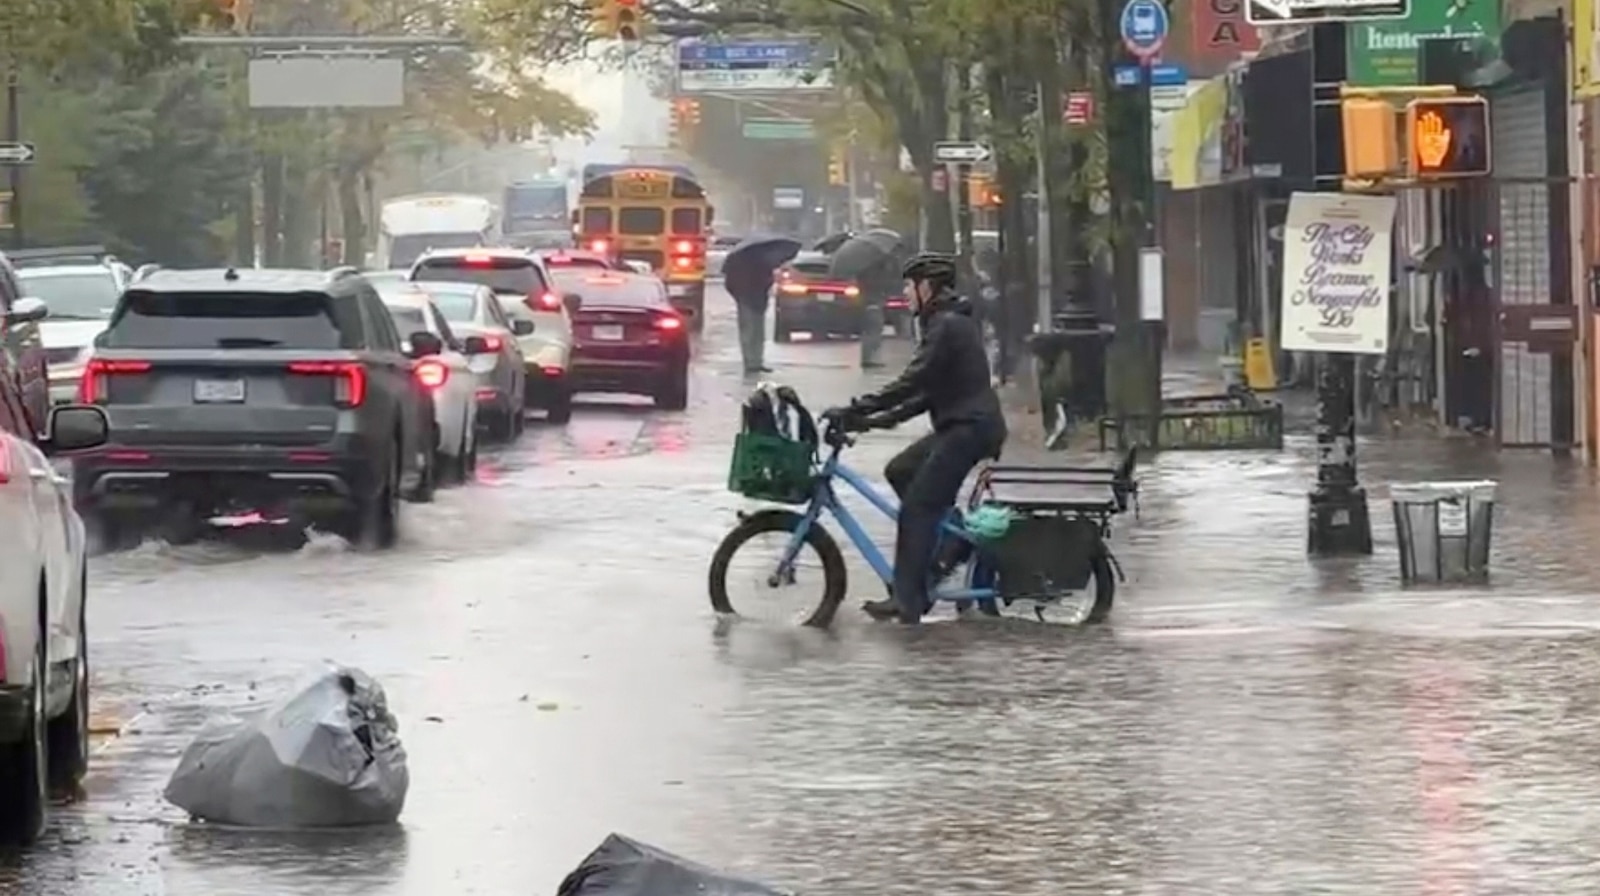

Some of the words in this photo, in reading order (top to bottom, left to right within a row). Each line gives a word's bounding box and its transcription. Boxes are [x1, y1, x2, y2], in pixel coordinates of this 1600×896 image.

[1301, 222, 1339, 246] The
[1341, 223, 1375, 248] City
[1311, 243, 1363, 266] Works
[1300, 264, 1375, 289] Because
[1291, 286, 1381, 311] Nonprofits
[1318, 306, 1354, 327] Do
